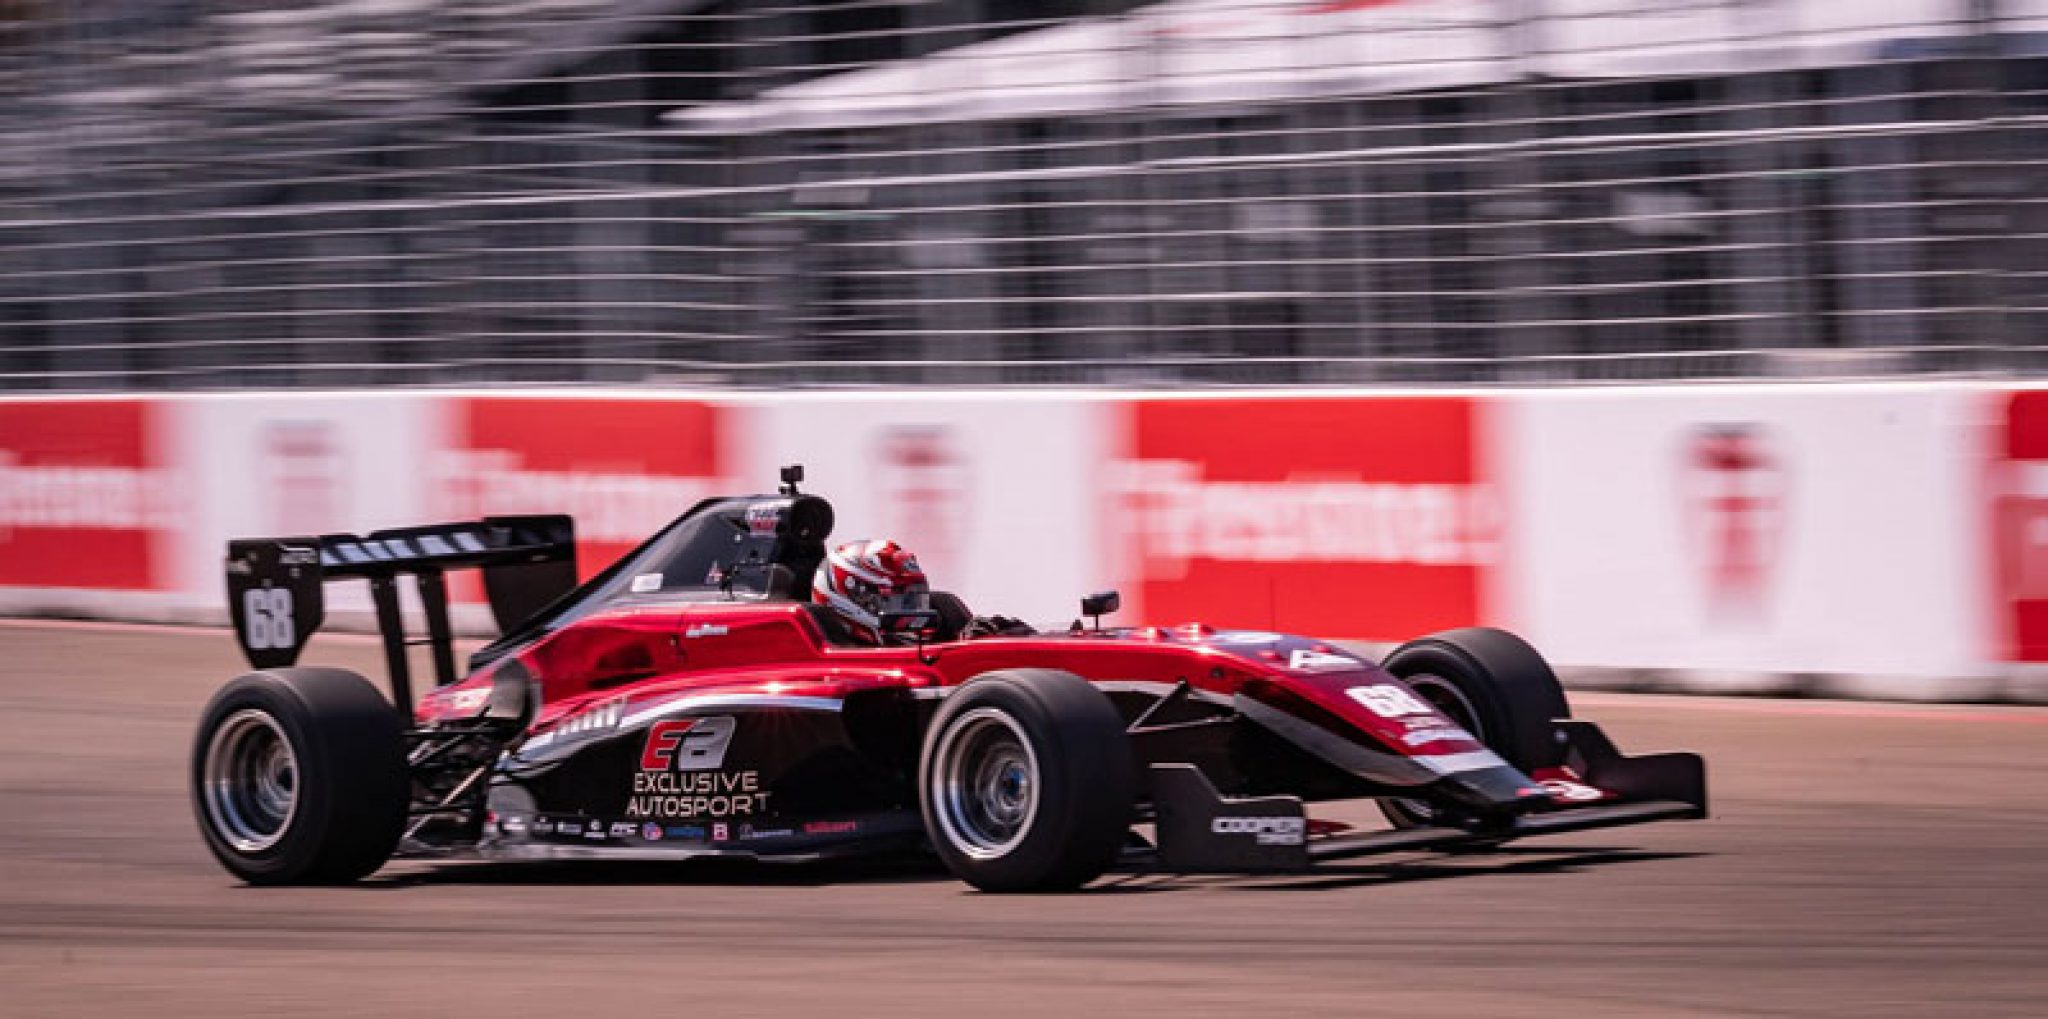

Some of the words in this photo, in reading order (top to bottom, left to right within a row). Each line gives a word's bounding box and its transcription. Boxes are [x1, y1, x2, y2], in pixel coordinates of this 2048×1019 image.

[243, 588, 296, 649] 68
[633, 770, 759, 793] EXCLUSIVE
[626, 790, 772, 817] AUTOSPORT
